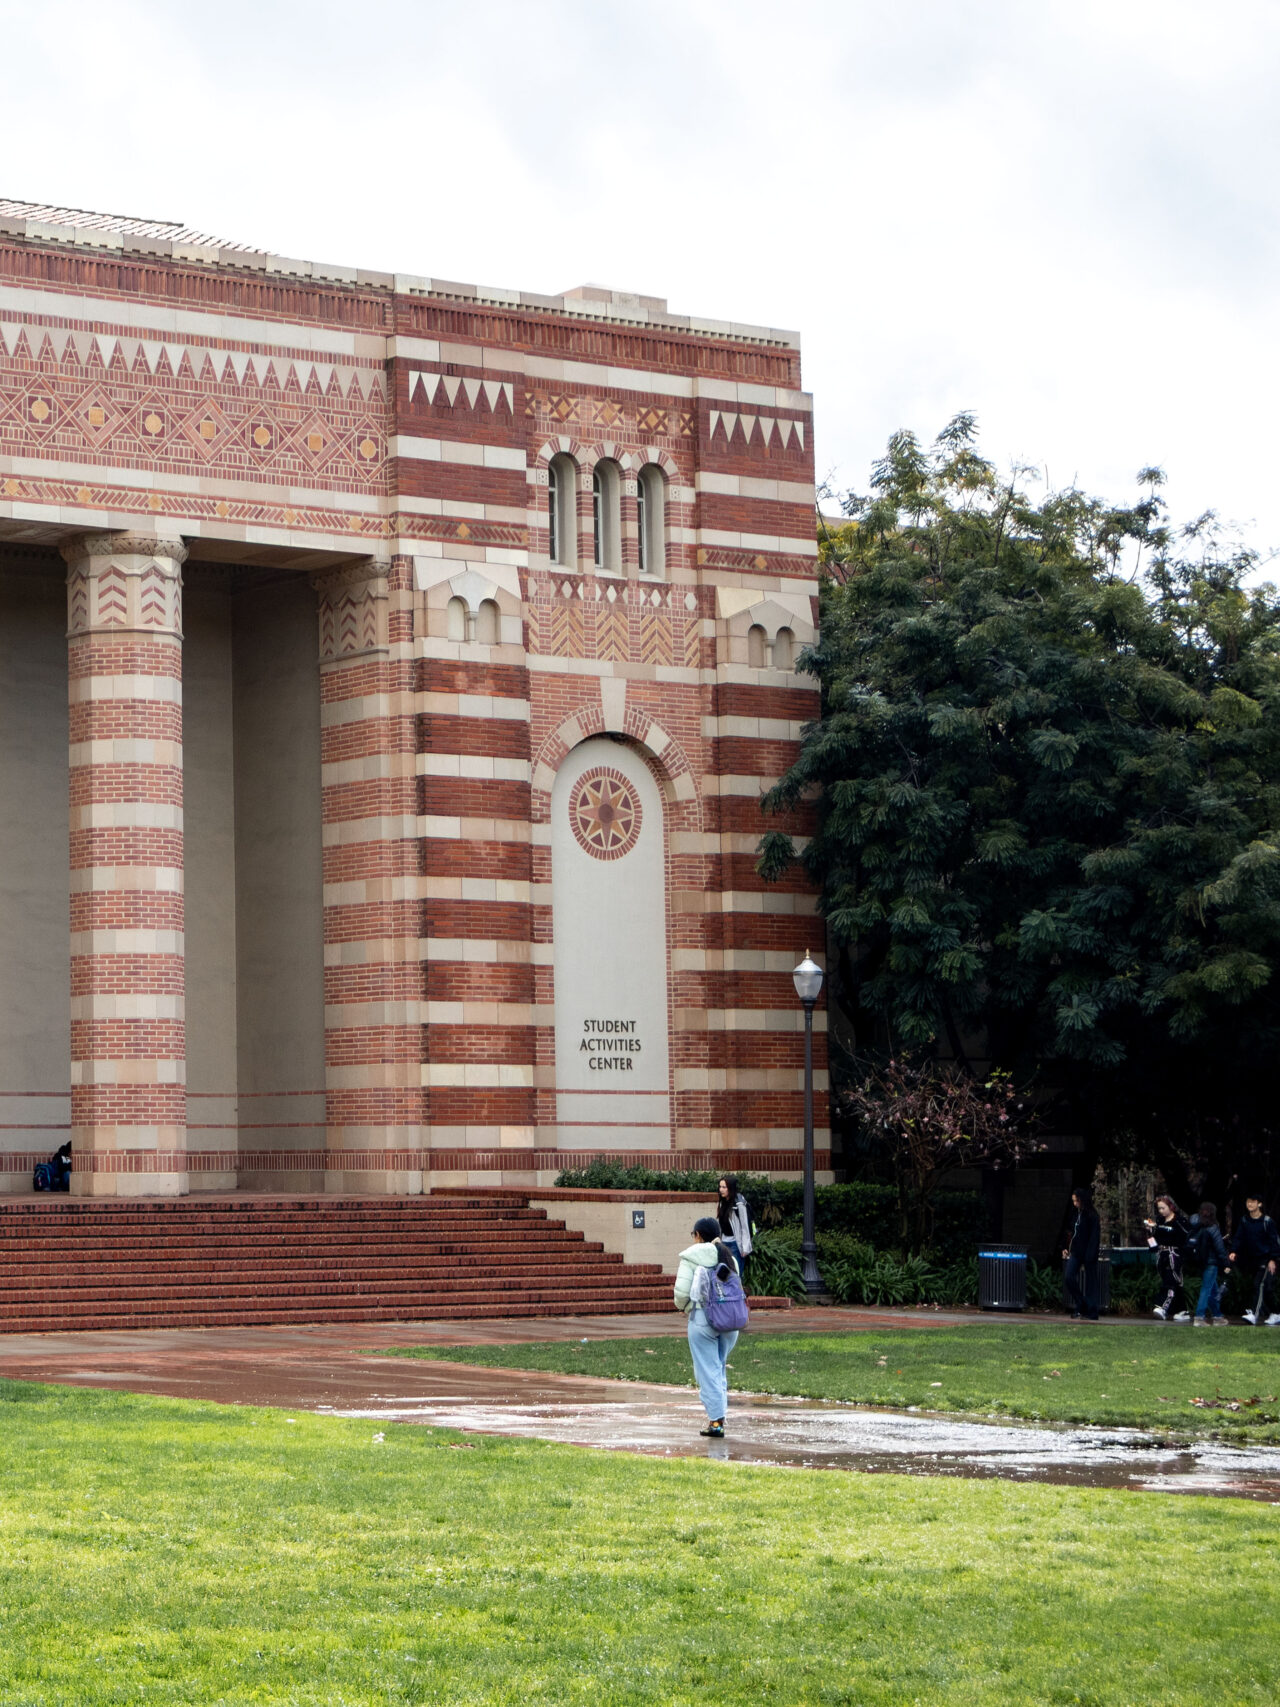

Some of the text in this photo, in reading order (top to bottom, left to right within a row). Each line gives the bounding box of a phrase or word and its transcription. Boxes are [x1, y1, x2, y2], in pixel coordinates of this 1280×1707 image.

[584, 1020, 636, 1033] STUDENT
[579, 1038, 641, 1052] ACTIVITIES
[588, 1057, 633, 1070] CENTER
